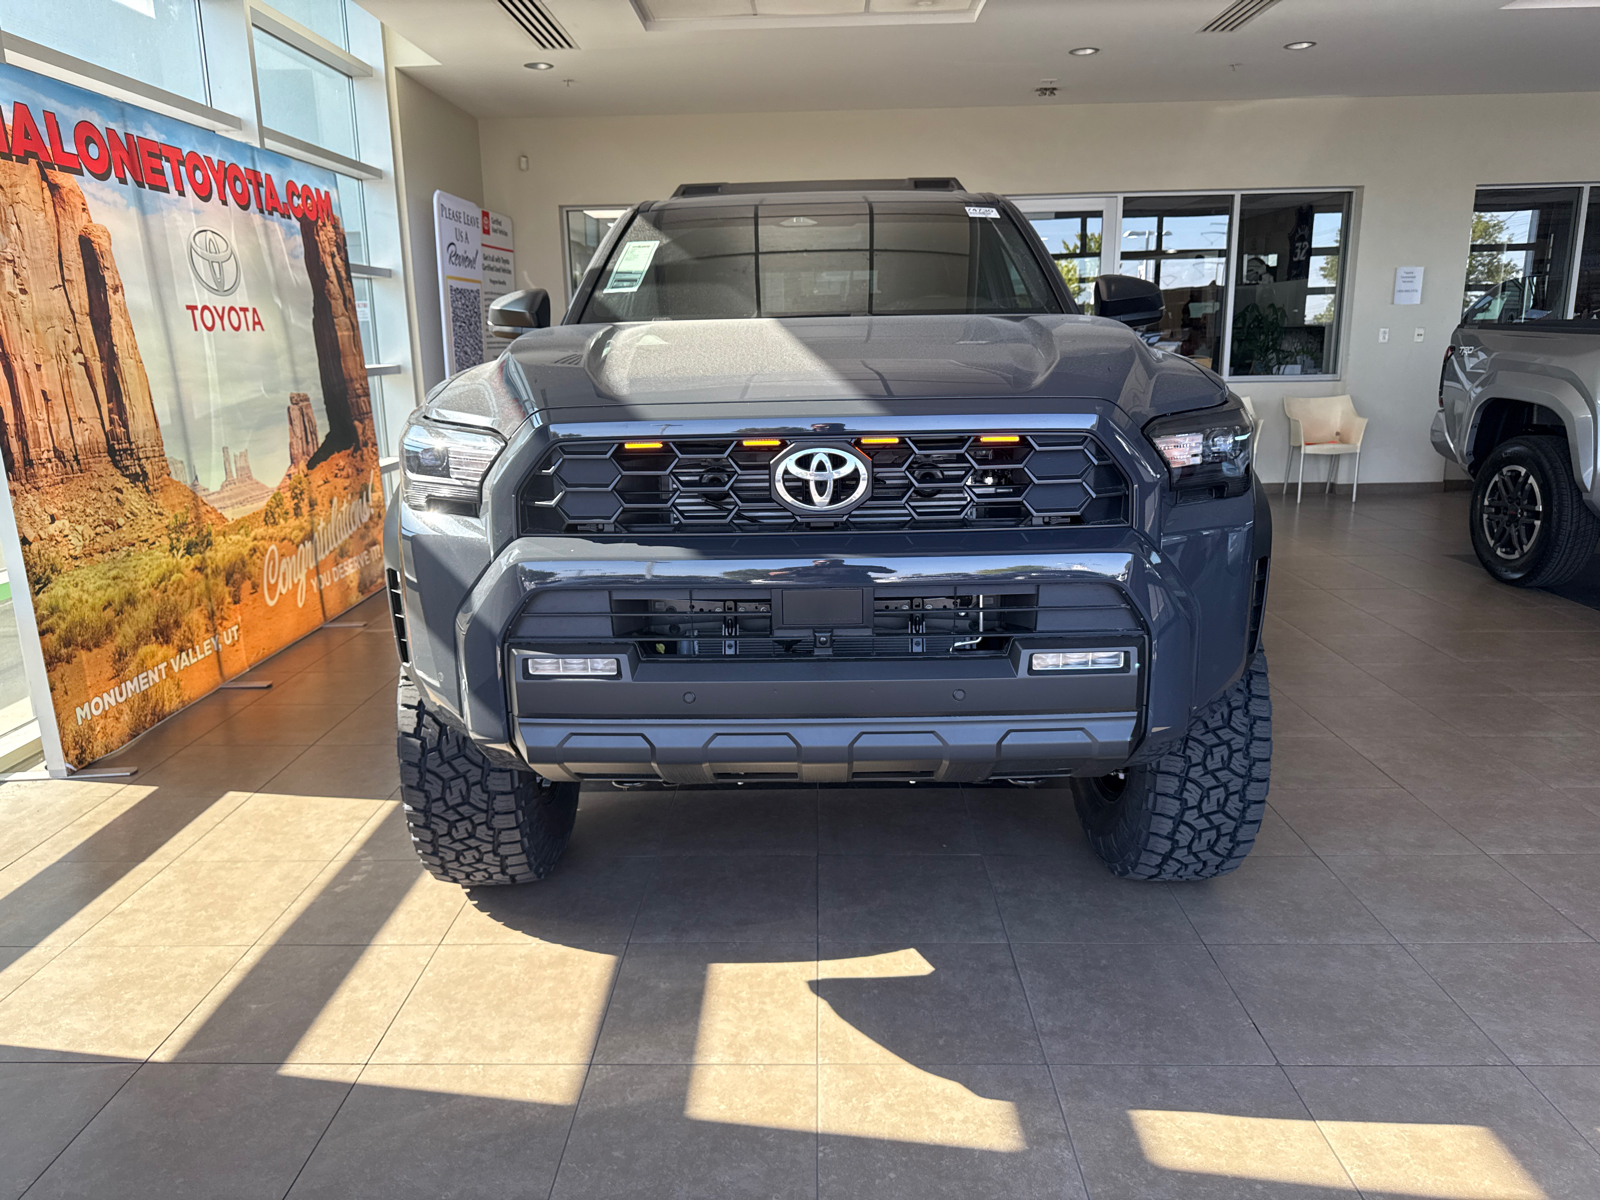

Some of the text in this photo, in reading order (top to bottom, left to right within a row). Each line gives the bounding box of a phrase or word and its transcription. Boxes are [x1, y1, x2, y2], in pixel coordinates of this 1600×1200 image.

[440, 203, 480, 229] PLEASE LEAVE
[1293, 241, 1309, 261] 32
[186, 304, 265, 332] TOYOTA
[1459, 346, 1474, 356] TRD
[263, 469, 374, 608] Congratulations!
[310, 569, 332, 593] YOU
[331, 550, 371, 582] DESERVE
[75, 624, 240, 726] MONUMENT VALLEY, UT
